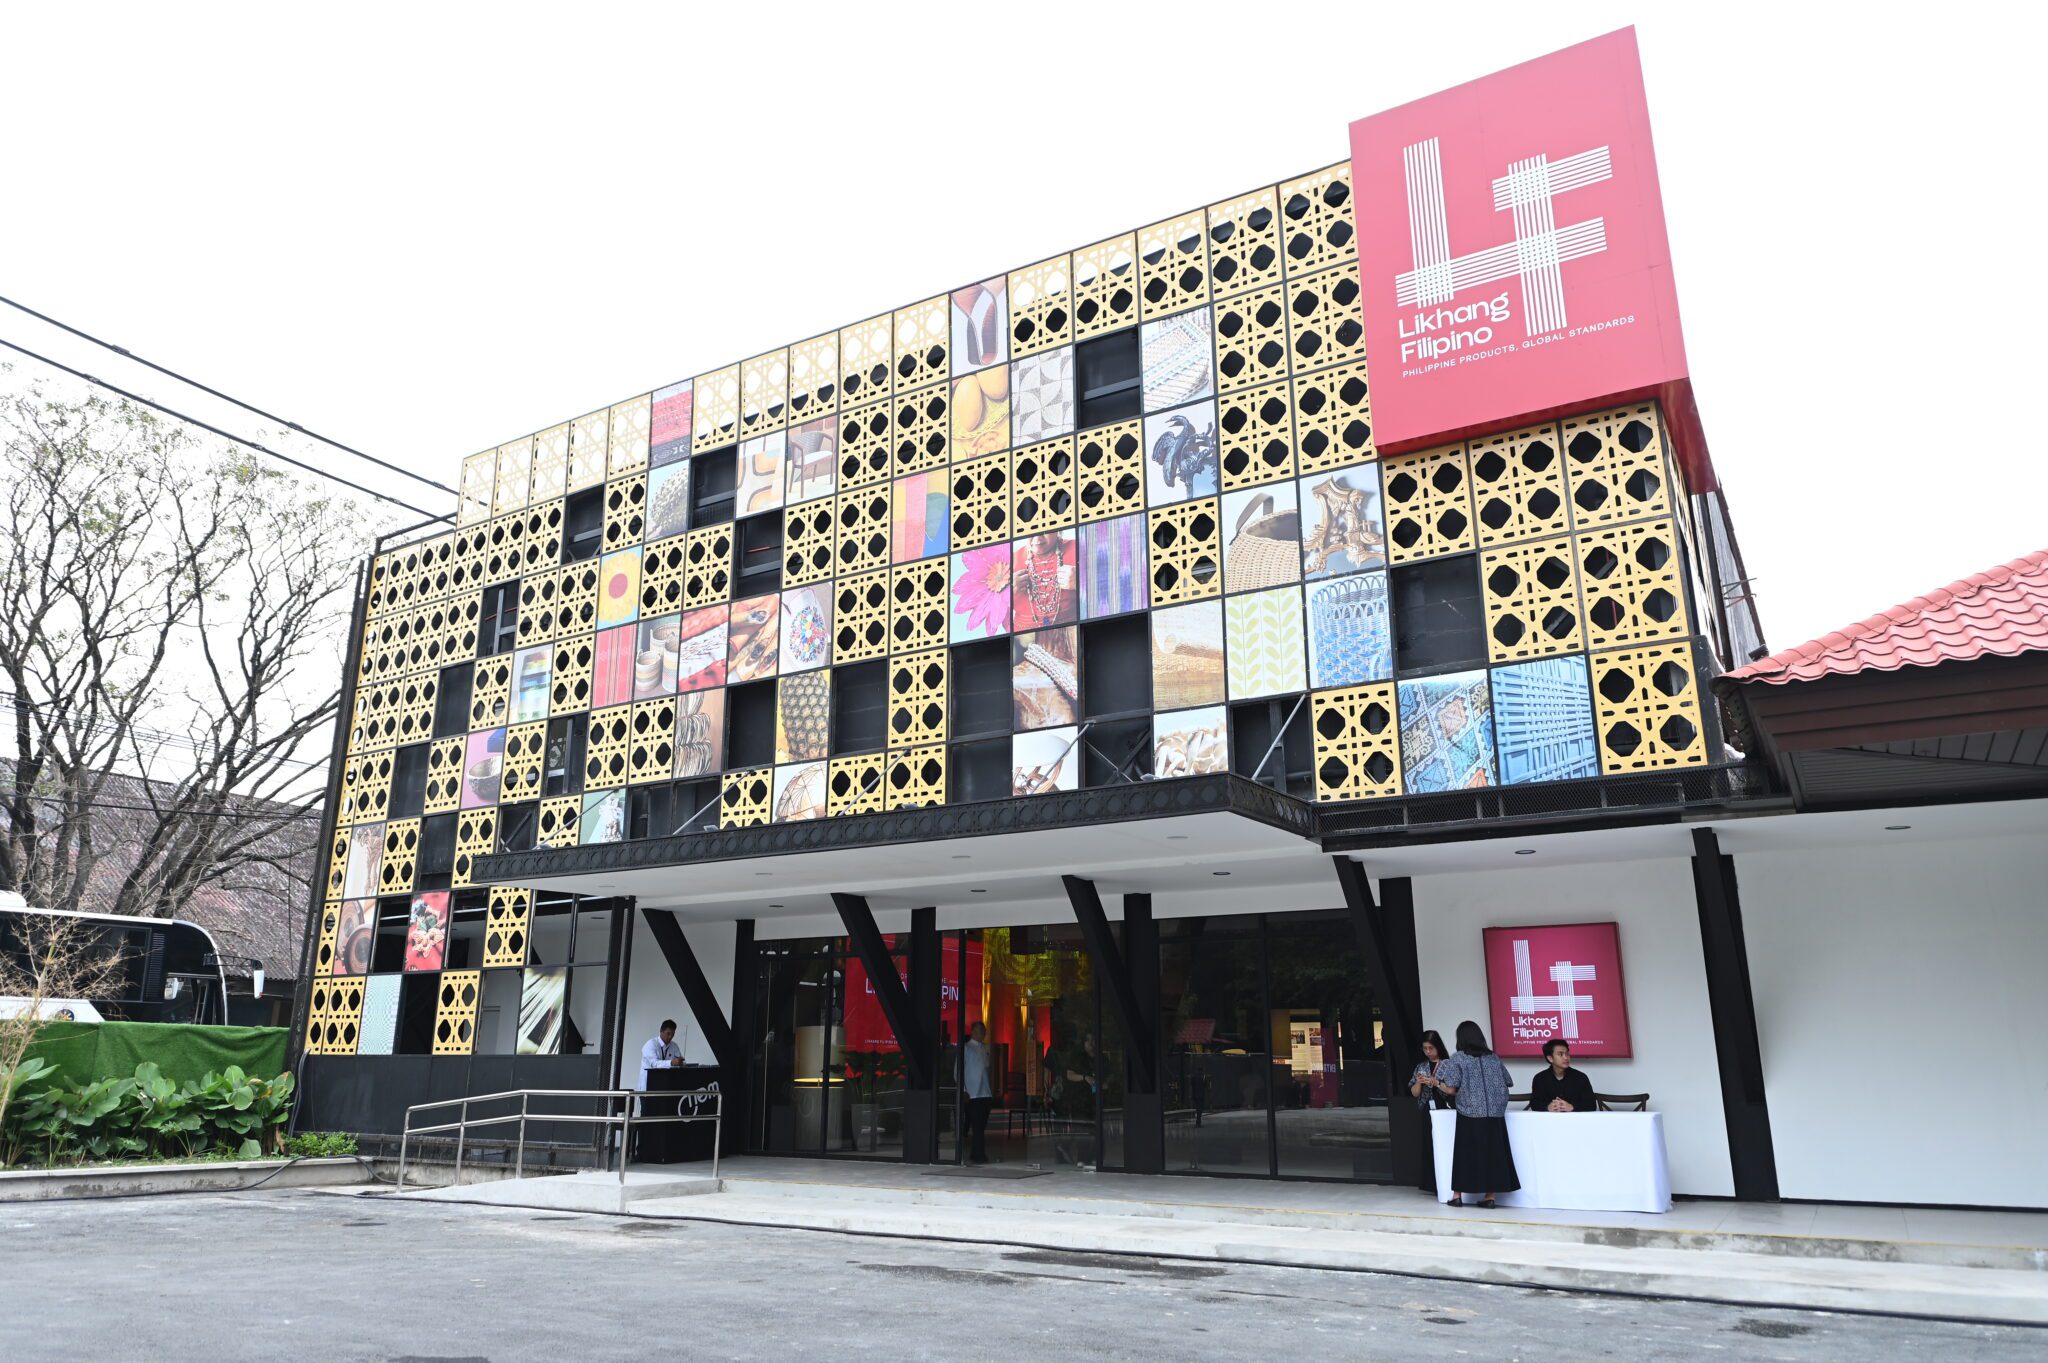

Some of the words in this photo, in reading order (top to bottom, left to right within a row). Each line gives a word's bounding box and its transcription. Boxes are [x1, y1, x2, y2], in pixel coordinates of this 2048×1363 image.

[1398, 291, 1511, 339] Likhang
[1401, 326, 1493, 364] Filipino
[1402, 358, 1457, 378] PHILIPPINE
[1459, 344, 1519, 364] PRODUCTS,
[1522, 332, 1566, 349] GLOBAL
[1568, 315, 1636, 338] STANDARDS
[1511, 1016, 1559, 1029] Likhang
[1513, 1028, 1551, 1039] Filipino
